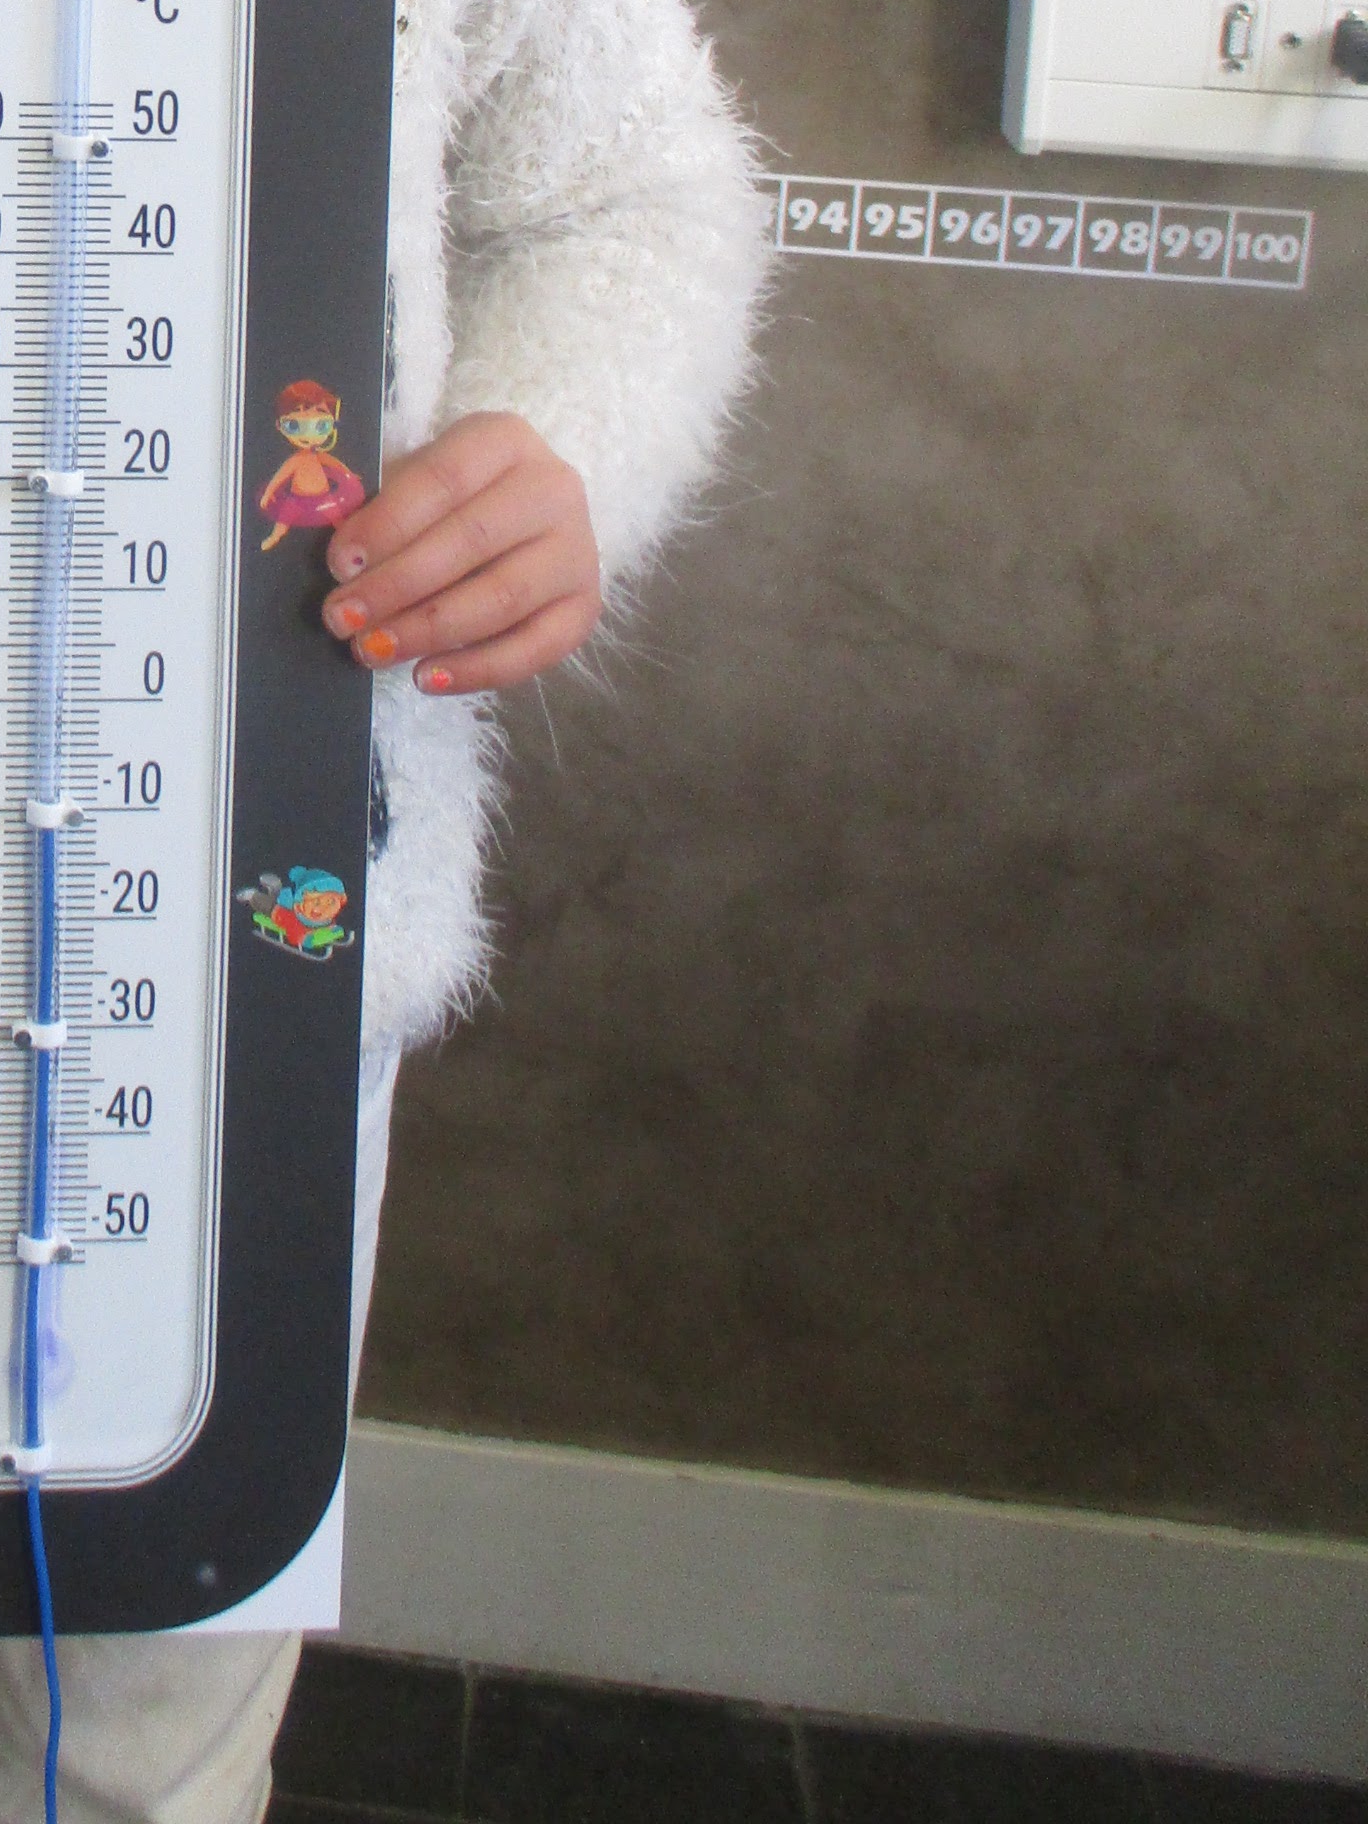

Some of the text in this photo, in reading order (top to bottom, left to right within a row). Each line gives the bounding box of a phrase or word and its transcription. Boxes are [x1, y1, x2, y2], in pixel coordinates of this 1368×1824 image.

[132, 90, 178, 135] 50
[128, 204, 176, 248] 40
[788, 198, 1300, 264] 94 95 96 97 98 99 100
[126, 317, 173, 361] 30
[124, 429, 170, 473] 20
[123, 540, 167, 584] 10
[144, 651, 164, 694] 0
